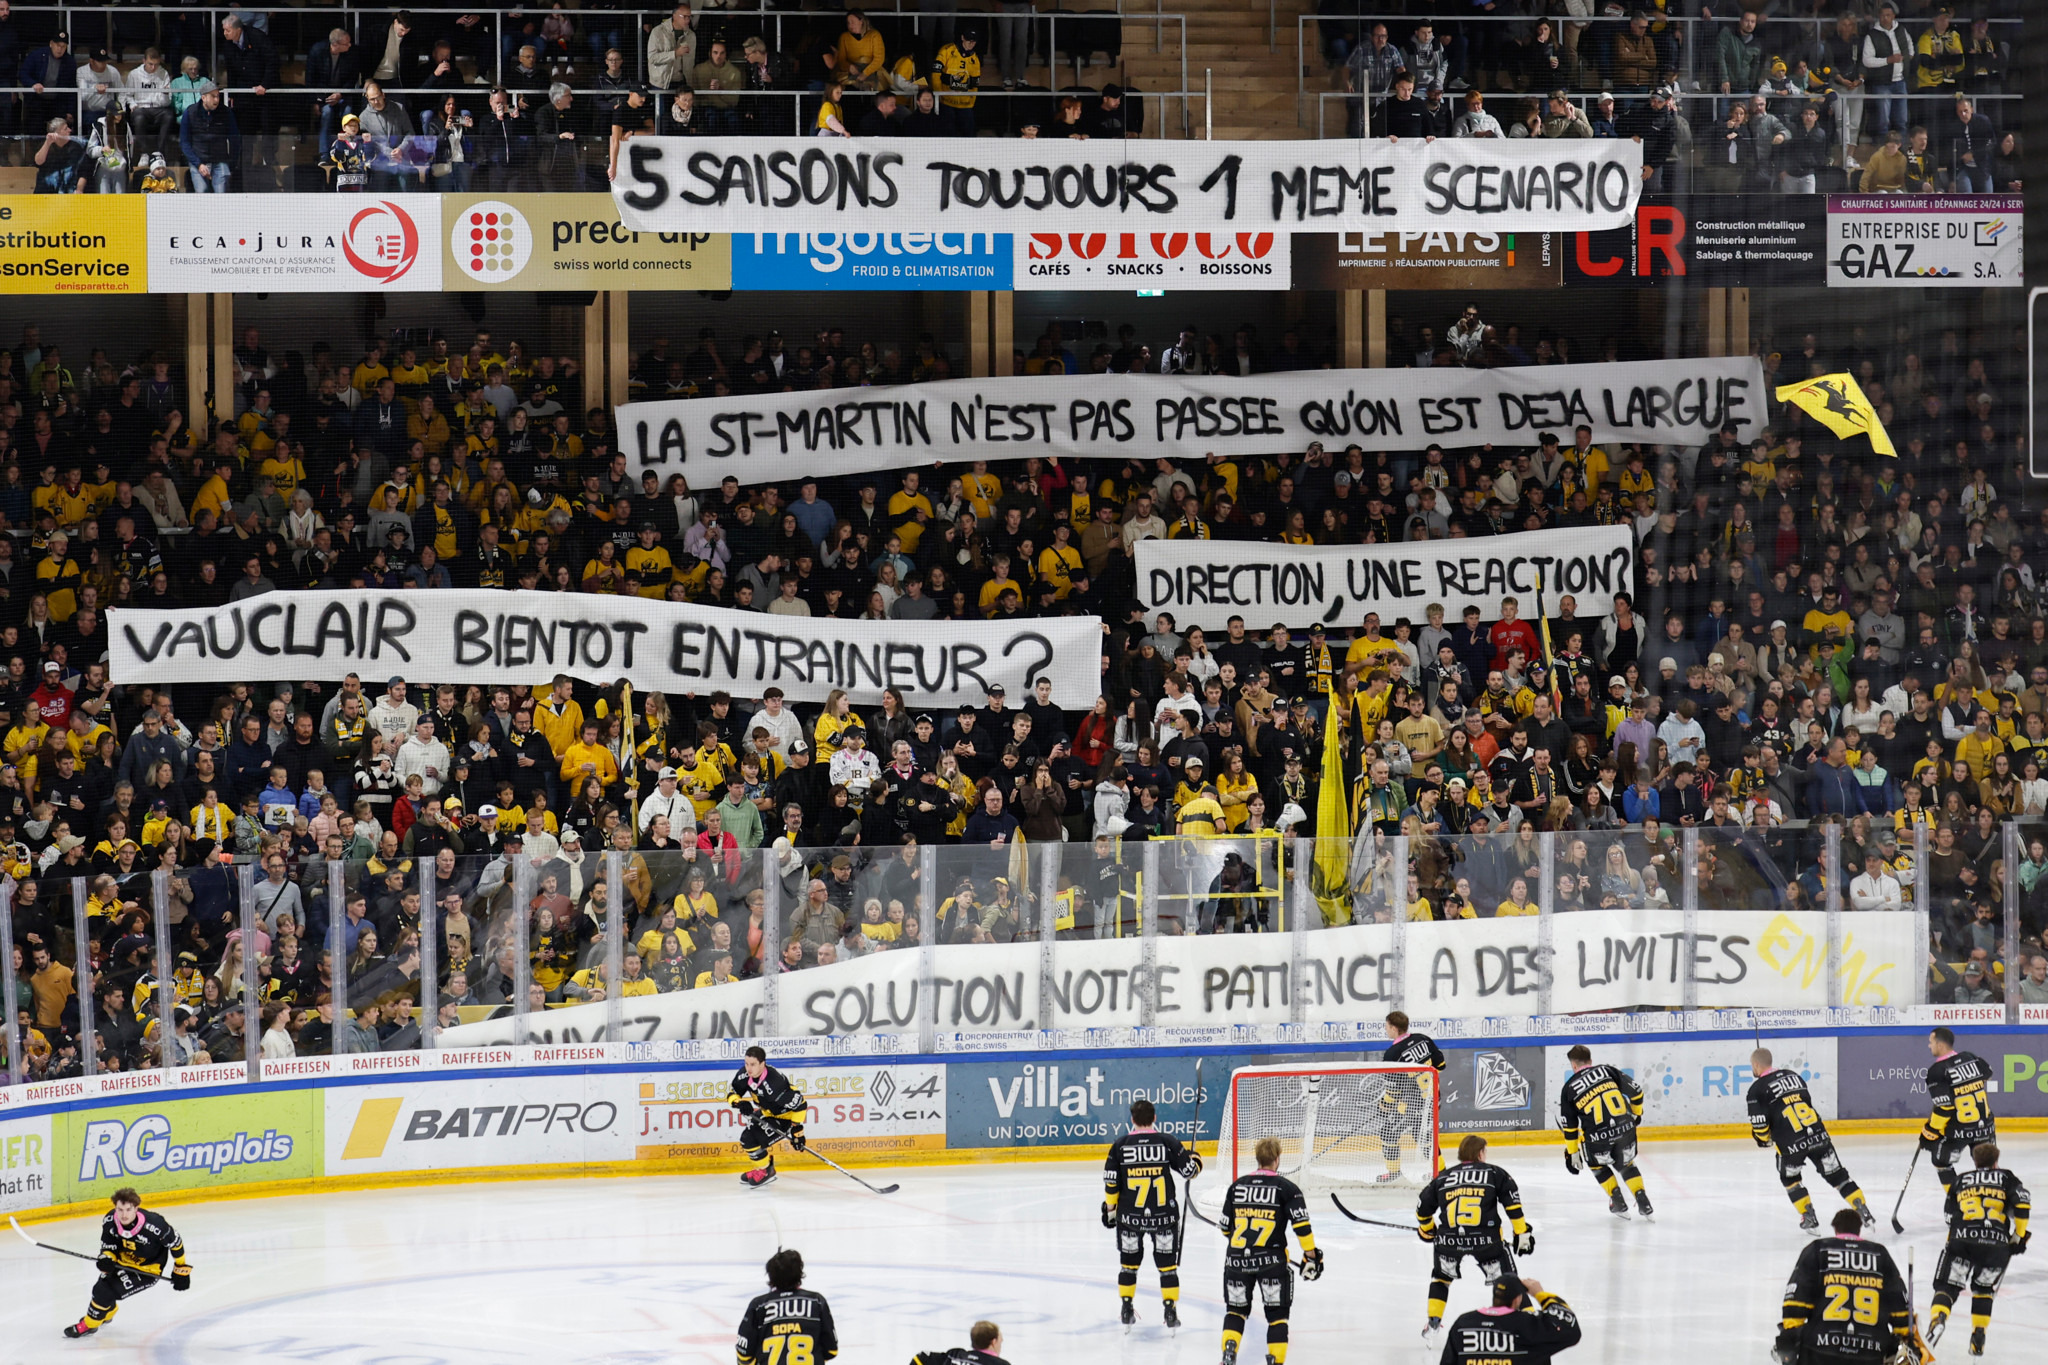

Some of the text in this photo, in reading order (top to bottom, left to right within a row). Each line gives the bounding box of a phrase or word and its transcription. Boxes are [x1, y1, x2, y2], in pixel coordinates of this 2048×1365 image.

[624, 146, 1630, 221] 5 SAISONS TOUJOURS 1 MEME SCENARIO
[1841, 198, 2001, 209] CHAUFFAGE SANITAIRE DÉPANNAGE 24/24
[1696, 219, 1806, 232] Construction métallique
[1841, 222, 1968, 239] ENTREPRISE DU
[1399, 232, 1500, 253] PAYS
[1696, 236, 1797, 245] Menuiserie aluminium
[170, 255, 336, 265] ÉTABLISSEMENT CANTONAL D'ASSURANCE
[1338, 259, 1387, 268] IMPRIMERIE
[1395, 257, 1447, 268] RÉALISATION
[1447, 259, 1500, 268] PUBLICITAIRE
[1696, 250, 1814, 261] Sablage & thermolaquage
[1839, 243, 2002, 278] GAZ S.A.
[211, 265, 261, 275] IMMOBILIÈRE
[286, 265, 336, 274] PRÉVENTION
[554, 259, 692, 270] swiss world connects
[853, 265, 994, 276] FROID & CLIMATISATION
[1029, 261, 1273, 275] CAFÉS SNACKS BOISSONS
[55, 282, 129, 291] denisparatte.ch
[637, 376, 1752, 465] LA ST-MARTIN N'EST PAS PASSEE QU'ON EST DEJA LARGUE
[1347, 557, 1427, 601] UNE
[1436, 546, 1632, 597] REACTION?
[123, 597, 417, 664] VAUCLAIR
[454, 609, 649, 668] BIENTOT
[669, 622, 990, 694] ENTRAINEUR
[1055, 966, 1181, 1015] NOTRE
[1204, 952, 1404, 1013] PATIENCE
[1430, 946, 1457, 1000] A
[1476, 944, 1554, 998] DES
[1577, 932, 1751, 989] LIMITES
[1560, 1015, 1620, 1025] RECOUVREMENT
[1756, 1008, 1821, 1018] ORCPORRENTRUY
[1933, 1009, 2002, 1020] RAIFFEISEN
[1165, 1027, 1227, 1037] RECOUVREMENT
[1573, 1023, 1607, 1033] INKASSO
[757, 1038, 820, 1049] RECOUVREMENT
[964, 1031, 1034, 1042] ORCPORRENTRUY
[1179, 1035, 1214, 1044] INKASSO
[442, 1051, 512, 1065] RAIFFEISEN
[534, 1047, 605, 1061] RAIFFEISEN
[264, 1058, 331, 1077] RAIFFEISEN
[352, 1054, 421, 1071] RAIFFEISEN
[181, 1067, 245, 1084] RAIFFEISEN
[1869, 1068, 1885, 1081] LA
[101, 1074, 162, 1092] RAIFFEISEN
[817, 1074, 865, 1097] gare
[27, 1083, 83, 1100] RAIFFEISEN
[987, 1064, 1208, 1119] villat meubles
[1782, 1092, 1802, 1105] WICK
[1583, 1089, 1628, 1126] 70
[1954, 1089, 1991, 1124] 87
[403, 1100, 618, 1142] BATIPRO
[641, 1107, 659, 1137] j.
[833, 1103, 865, 1124] sa
[1448, 1118, 1532, 1129] INFO@SERTIDIAMS.CH
[1782, 1101, 1819, 1134] 19
[989, 1120, 1210, 1139] UN JOUR VOUS Y VNDREZ.
[668, 1145, 722, 1158] porrentruy
[816, 1137, 916, 1152] garagejmontavon.ch
[1127, 1166, 1163, 1177] MOTTET
[26, 1173, 43, 1191] fit
[1127, 1176, 1167, 1208] 71
[1445, 1187, 1486, 1201] CHRISTE
[1234, 1207, 1276, 1220] SCHMUTZ
[1446, 1196, 1482, 1229] 15
[1959, 1196, 2007, 1225] 82
[1121, 1213, 1176, 1227] MOUTIER
[1230, 1217, 1277, 1249] 27
[1438, 1235, 1493, 1246] MOUTIER
[121, 1239, 137, 1251] 13
[1823, 1273, 1884, 1290] PATENAUDE
[1822, 1285, 1880, 1327] 29
[772, 1322, 802, 1336] SOPA
[762, 1333, 815, 1365] 78
[1816, 1333, 1882, 1352] MOUTIER
